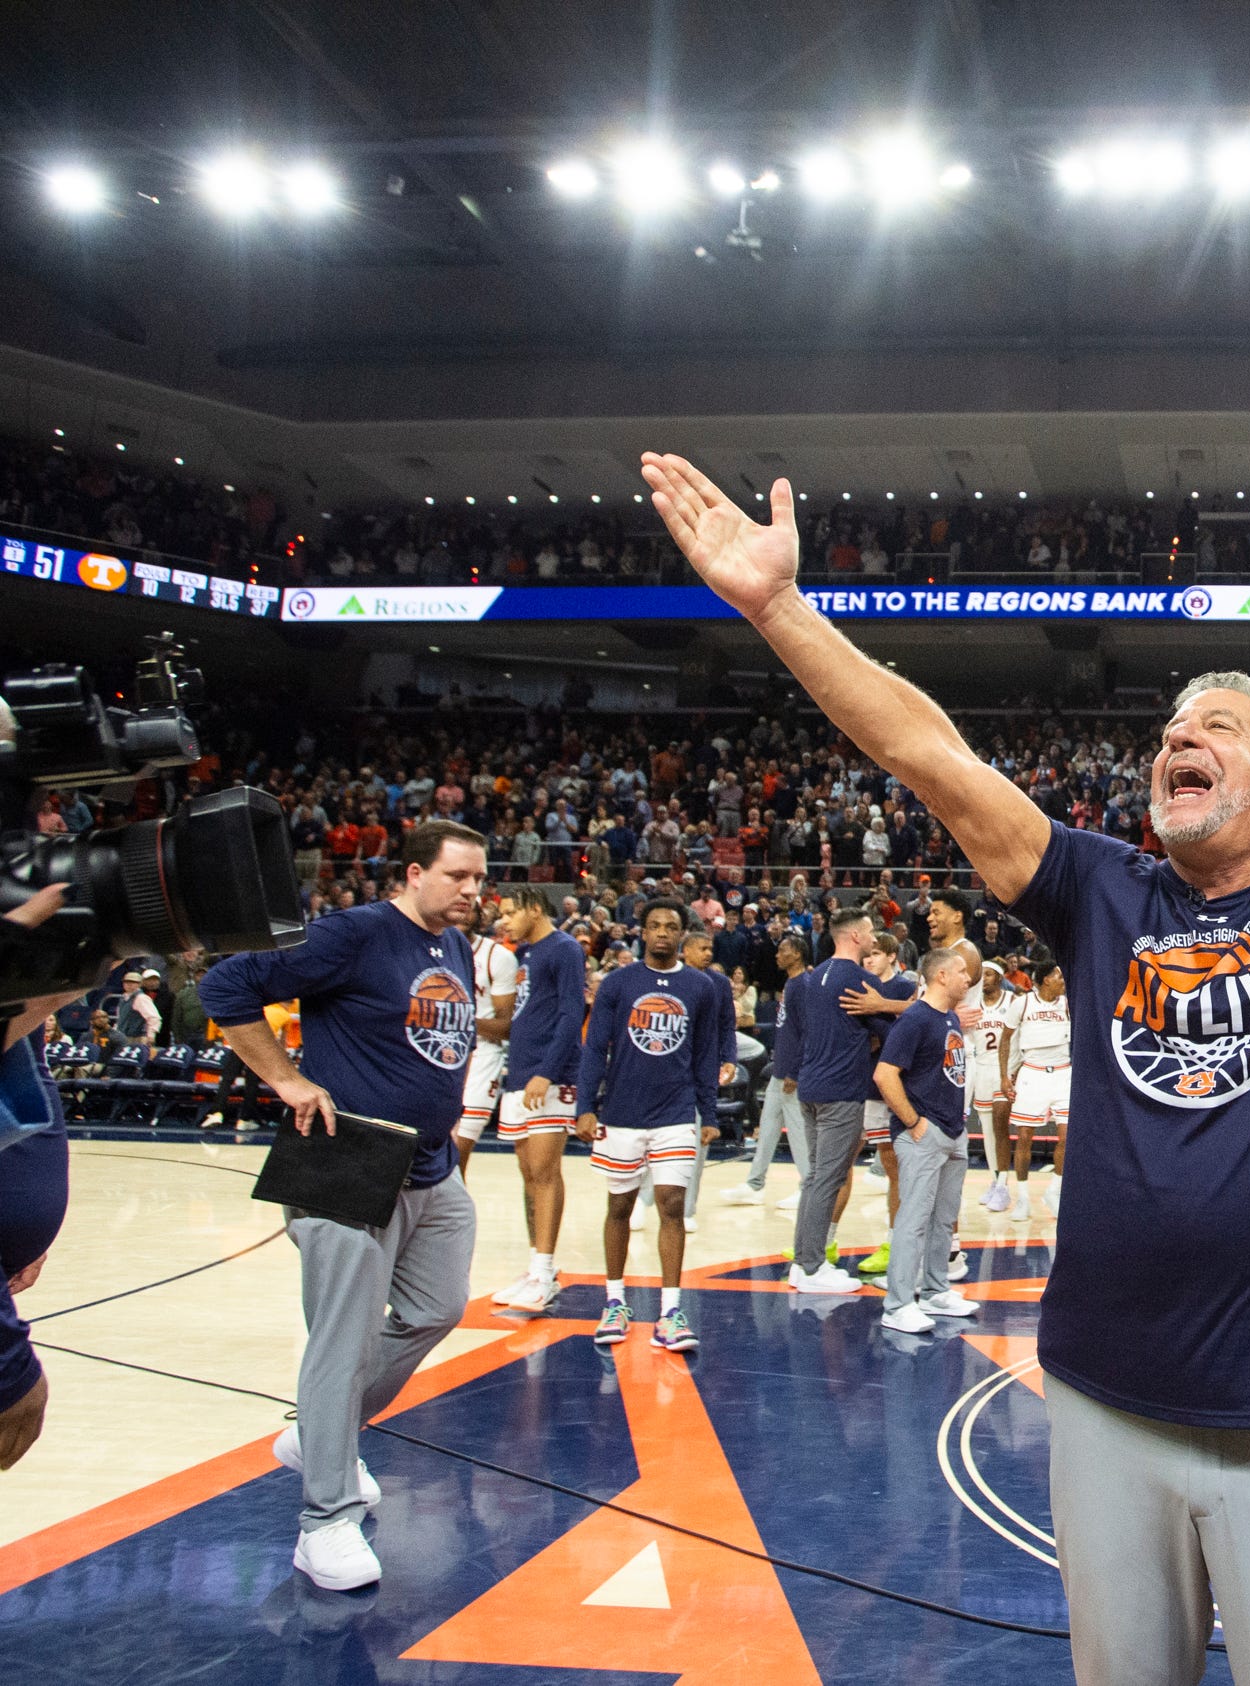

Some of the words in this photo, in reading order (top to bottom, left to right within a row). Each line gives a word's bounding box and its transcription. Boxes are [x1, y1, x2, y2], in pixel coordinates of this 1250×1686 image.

[34, 544, 65, 582] 51
[136, 566, 169, 581] FOULS
[181, 574, 199, 585] TO
[142, 579, 159, 597] 10
[180, 585, 196, 605] 12
[250, 587, 275, 599] REB
[374, 598, 469, 616] REGIONS
[804, 591, 867, 612] STEN
[872, 591, 906, 612] TO
[911, 591, 960, 612] THE
[965, 591, 1087, 613] REGIONS
[1090, 592, 1167, 613] BANK
[1213, 928, 1240, 943] FIGHT
[405, 997, 476, 1032] AUTLIVE
[628, 1008, 690, 1034] AUTLIVE
[976, 1020, 1005, 1030] UBUR
[985, 1032, 997, 1051] 2
